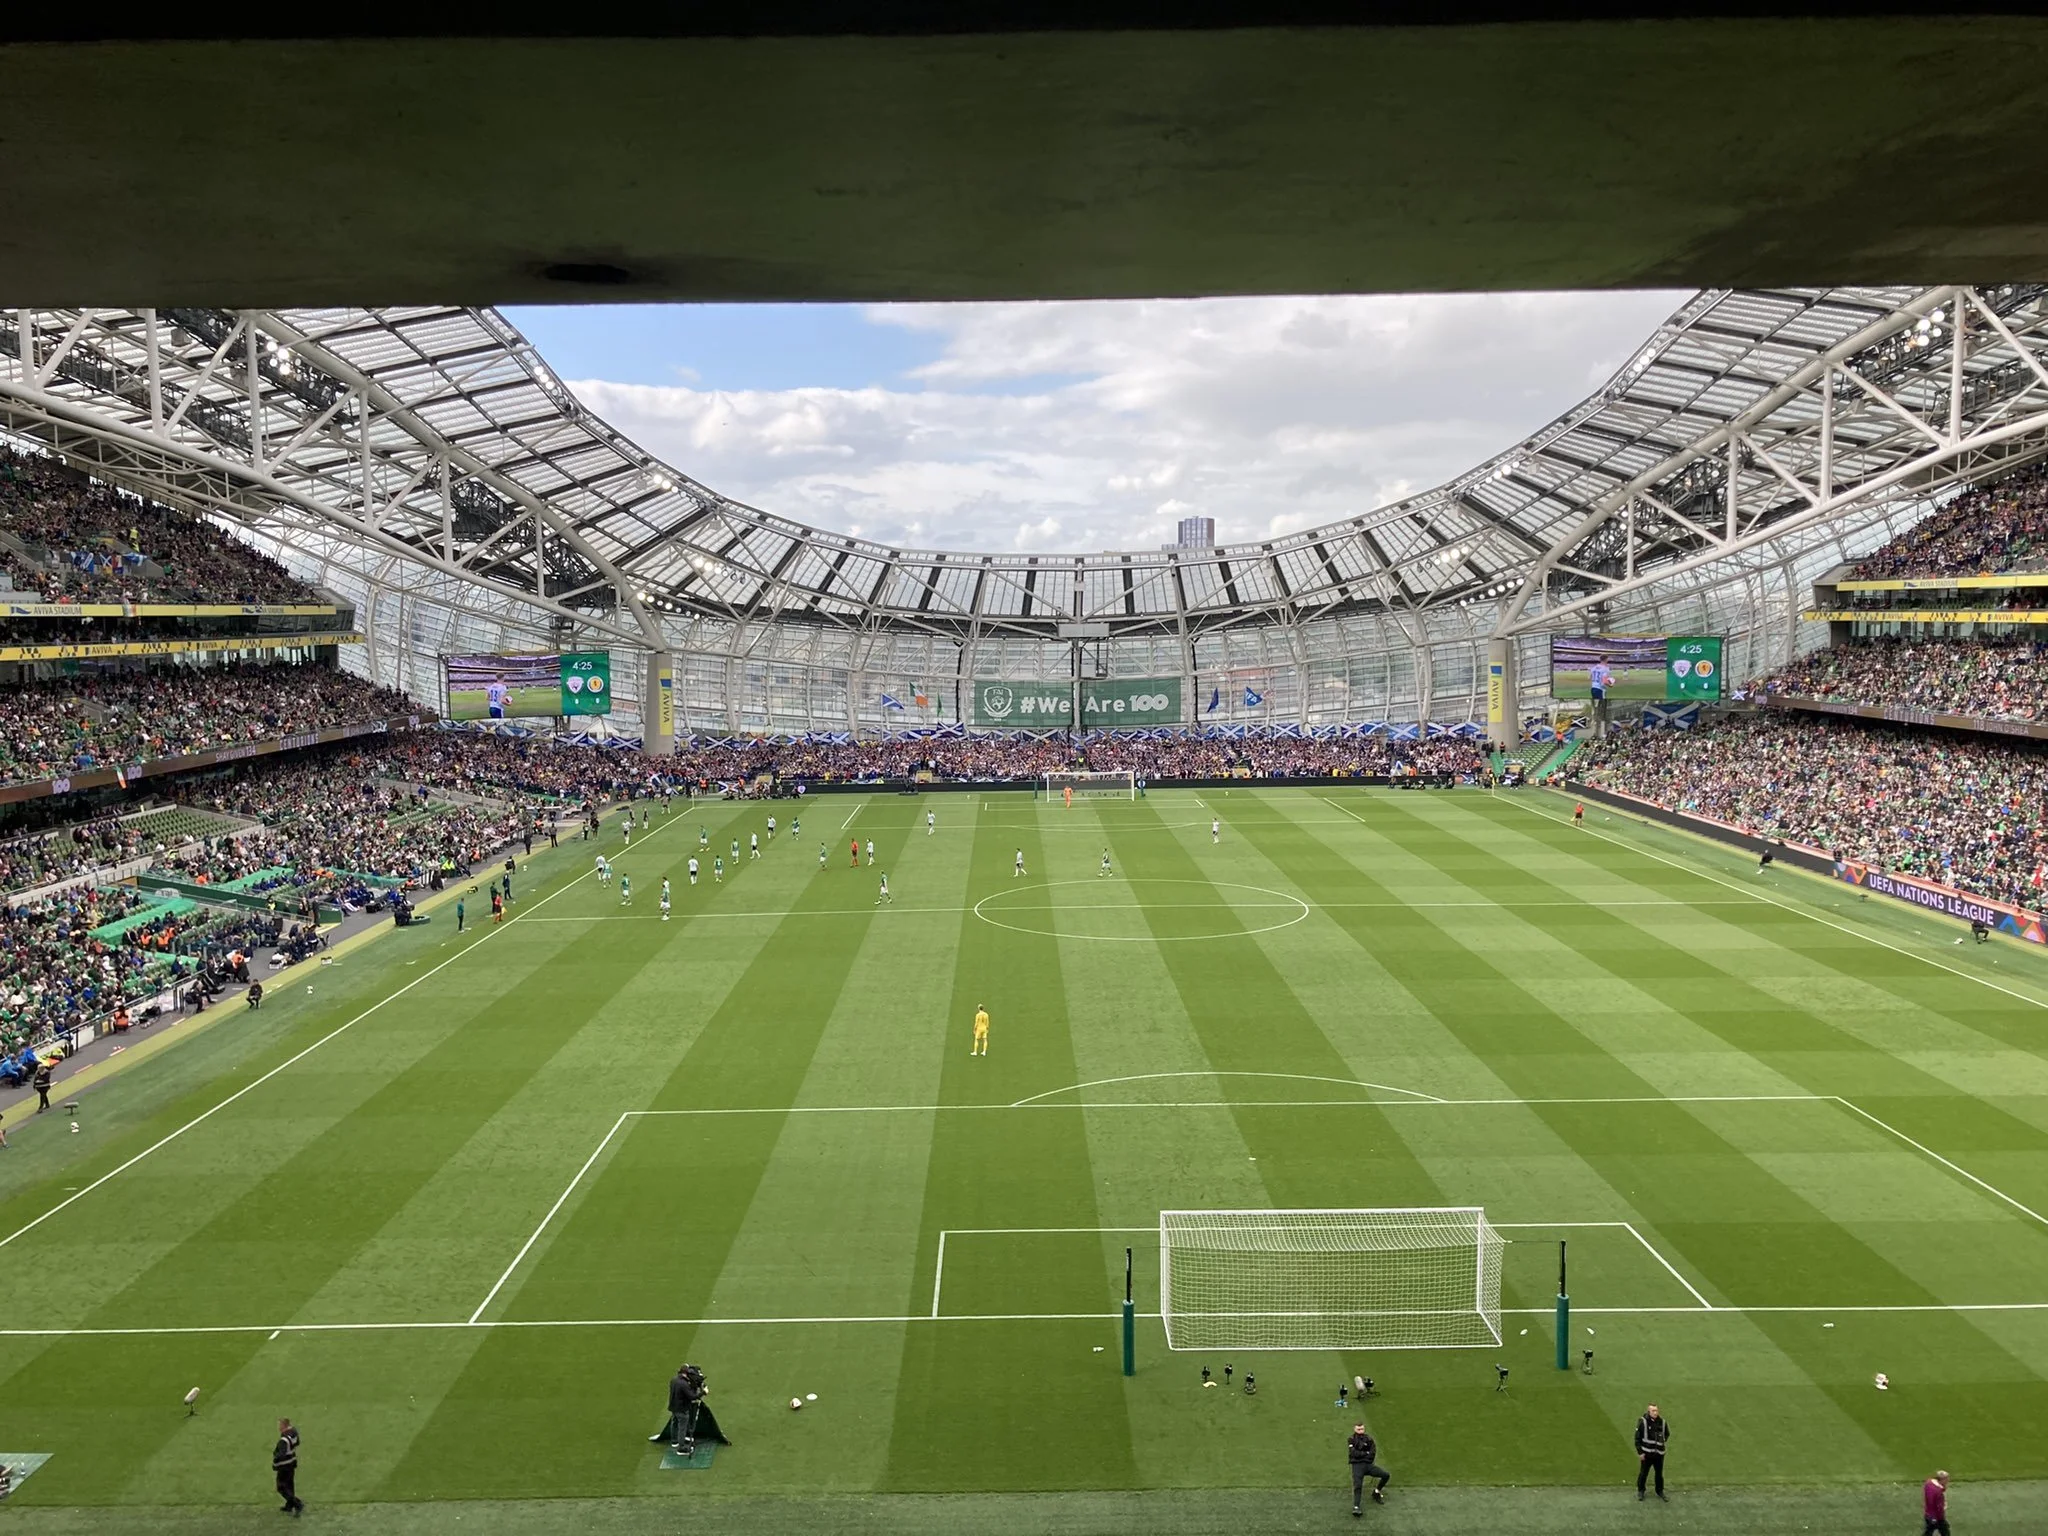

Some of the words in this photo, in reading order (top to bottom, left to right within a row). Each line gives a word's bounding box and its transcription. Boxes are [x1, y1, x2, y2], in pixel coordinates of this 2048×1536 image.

[34, 606, 52, 615] AVIVA
[53, 606, 82, 615] STADIUM
[91, 646, 113, 654] AVIVA
[1680, 646, 1702, 654] 4:25
[572, 662, 593, 670] 4:25
[1020, 696, 1070, 713] #We
[1085, 696, 1124, 713] Are
[1129, 694, 1169, 712] 100
[215, 750, 230, 762] SHAY
[230, 748, 245, 759] GIVEN
[246, 745, 256, 757] 134
[127, 765, 142, 780] 100
[53, 778, 70, 794] 100
[1869, 874, 1894, 894] UEFA
[1897, 882, 1945, 909] NATIONS
[1949, 898, 1994, 925] LEAGUE
